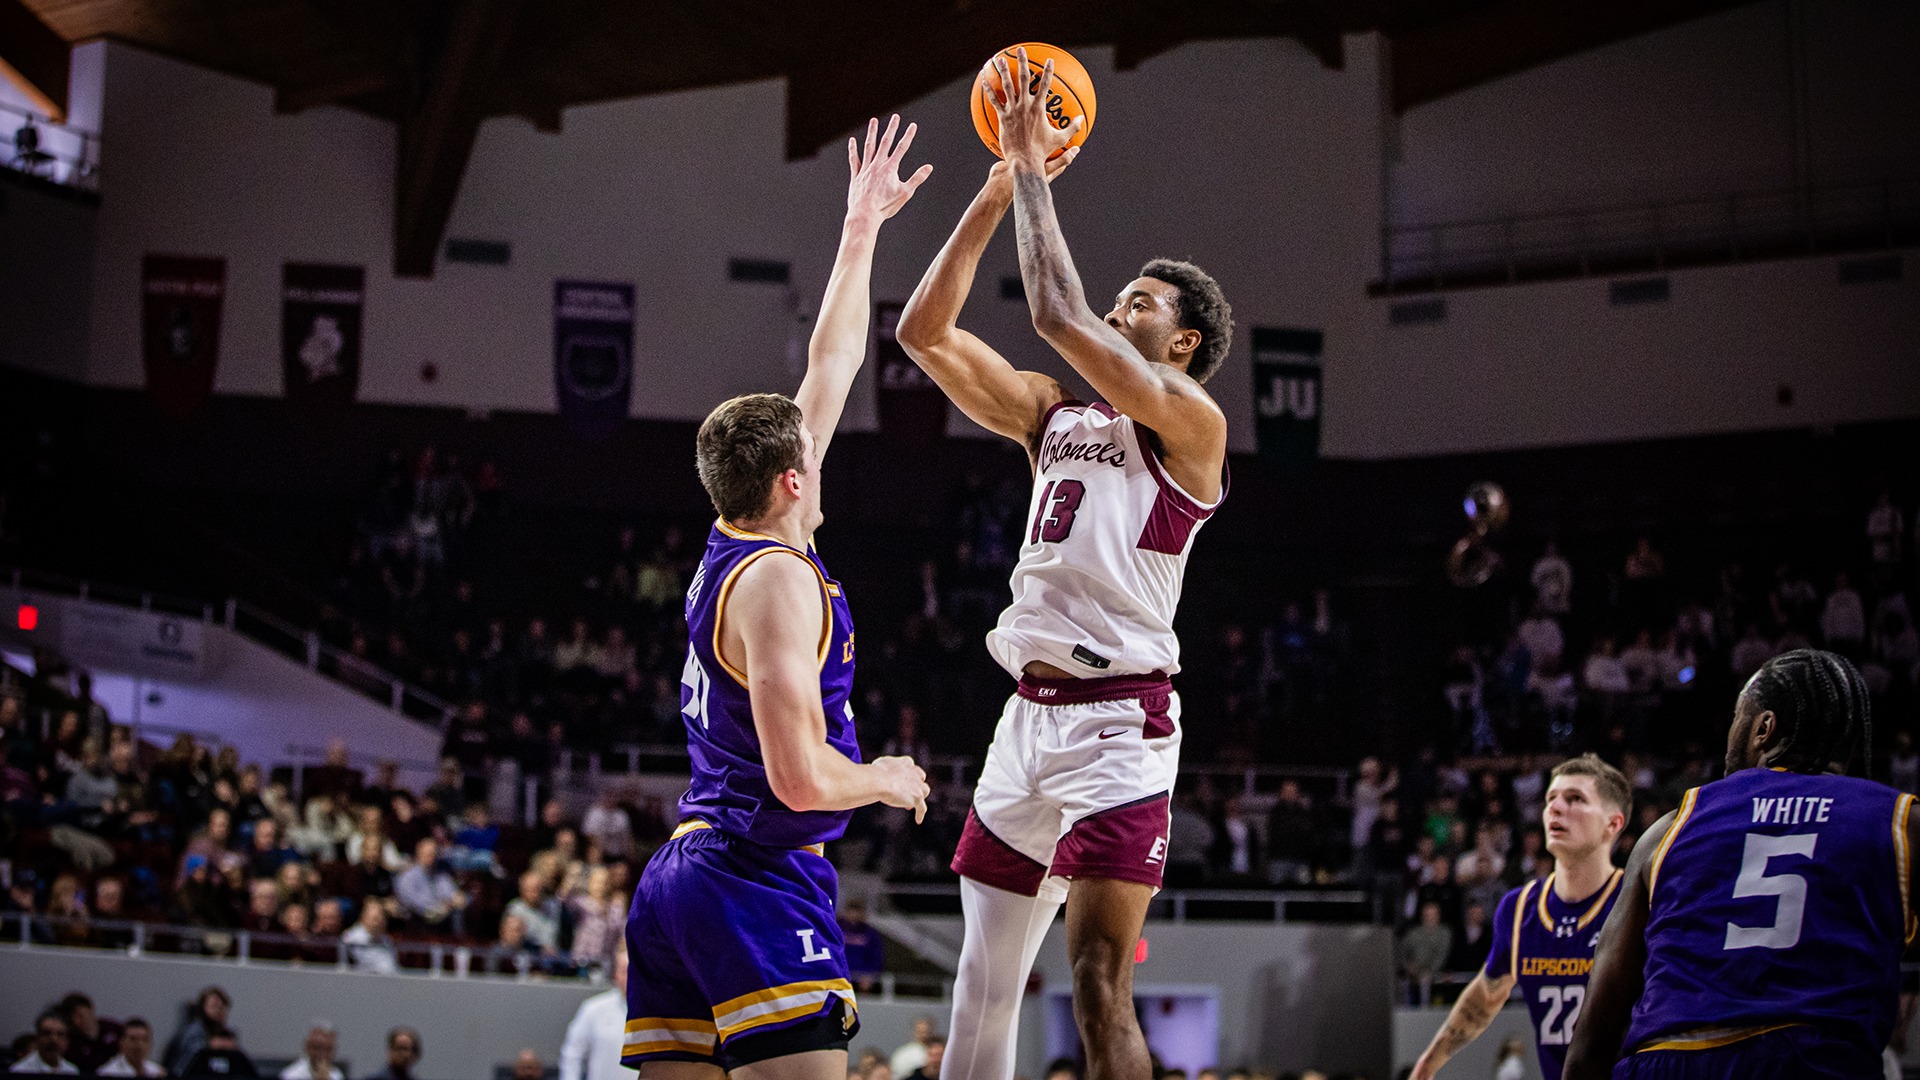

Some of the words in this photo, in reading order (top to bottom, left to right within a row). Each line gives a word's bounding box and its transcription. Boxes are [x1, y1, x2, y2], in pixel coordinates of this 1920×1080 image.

[1259, 375, 1316, 419] JU
[1041, 430, 1126, 475] Colonels
[1030, 478, 1087, 546] 13
[1038, 686, 1058, 697] EKU
[1751, 796, 1835, 825] WHITE
[1722, 832, 1819, 950] 5
[796, 928, 832, 963] L
[1521, 956, 1594, 976] LIPSCOM
[1538, 984, 1586, 1046] 22
